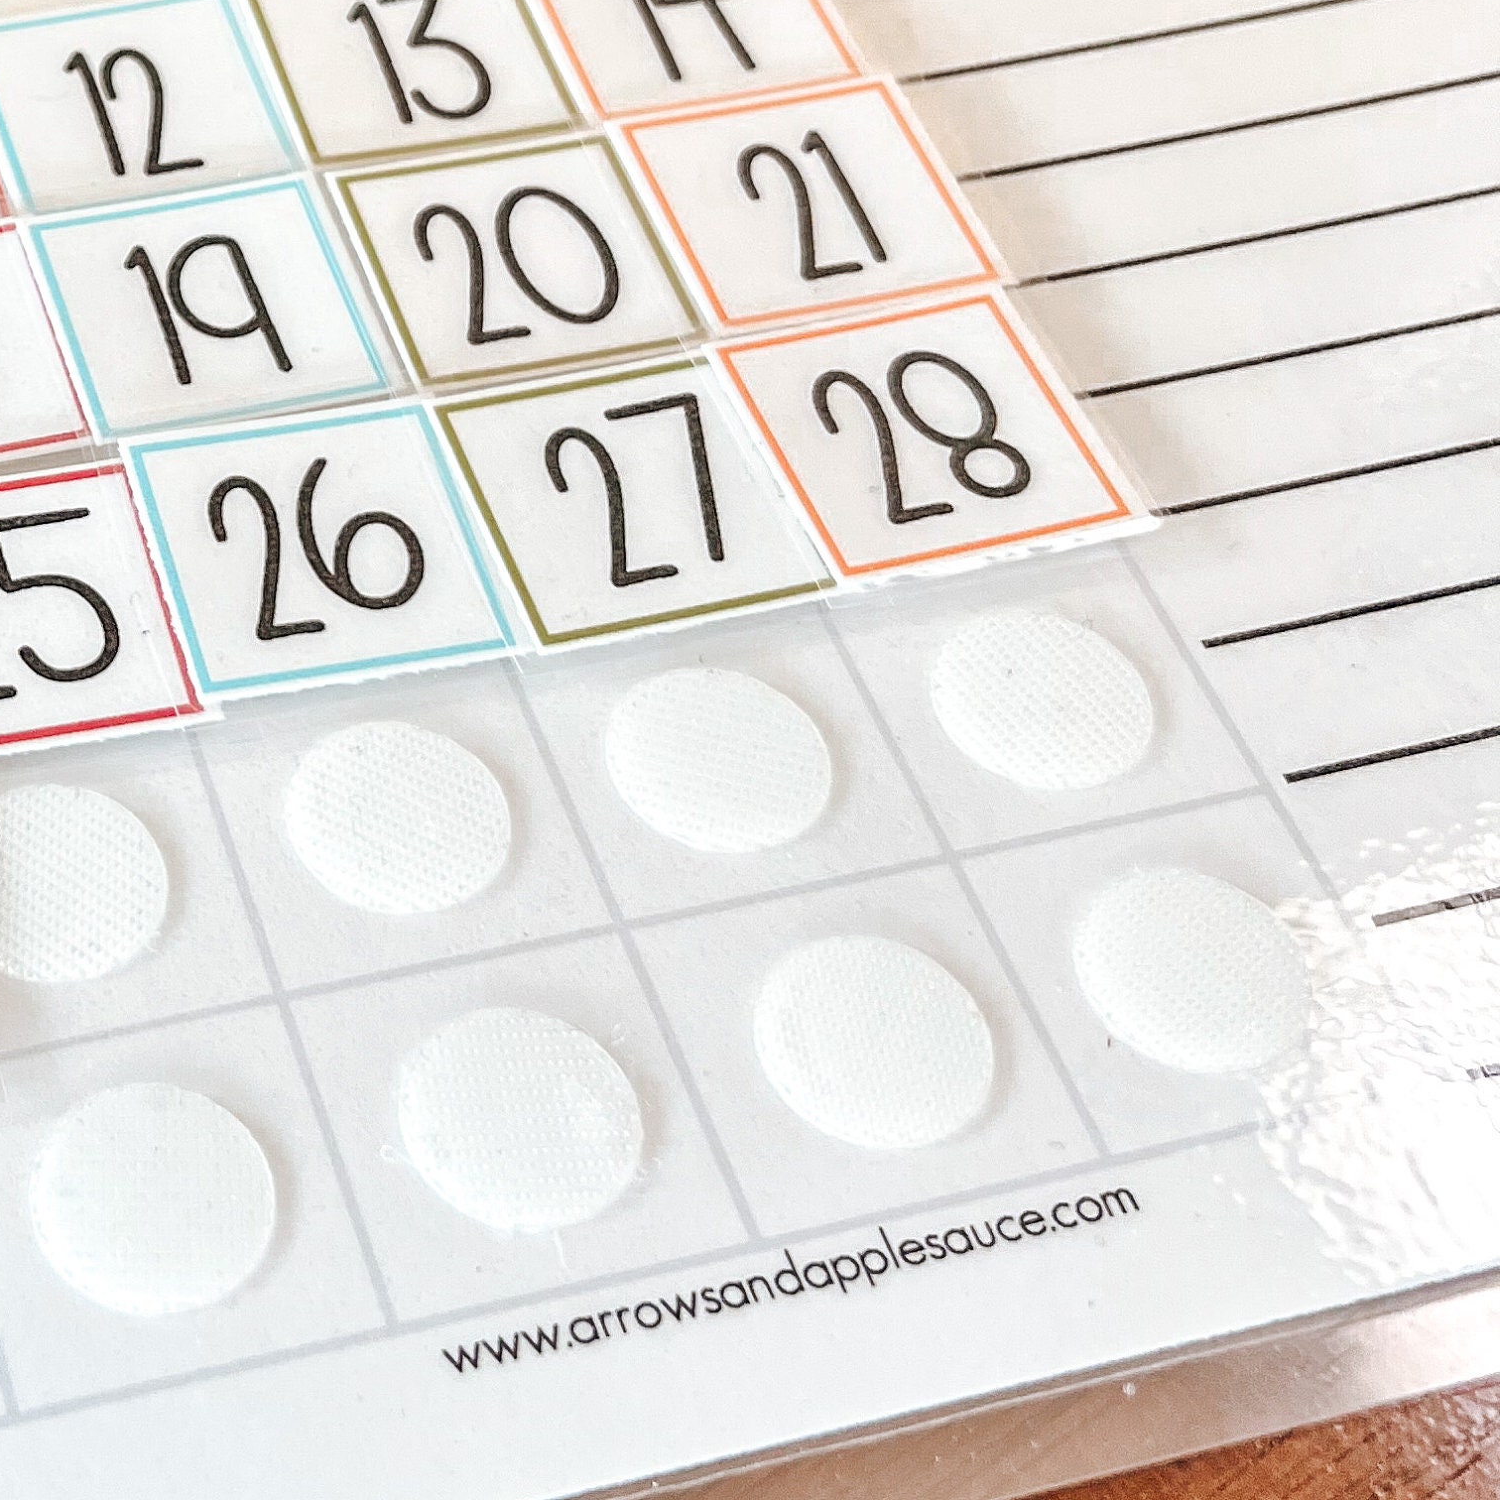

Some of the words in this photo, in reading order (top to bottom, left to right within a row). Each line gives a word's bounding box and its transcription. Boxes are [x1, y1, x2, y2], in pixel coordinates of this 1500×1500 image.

[65, 47, 207, 178] 12
[125, 234, 295, 387] 19
[414, 187, 620, 347] 20
[739, 130, 890, 282] 21
[207, 457, 426, 642] 26
[544, 392, 726, 589] 27
[812, 350, 1032, 526] 28
[442, 1184, 1140, 1374] www.arrowsandapplesauce.com
